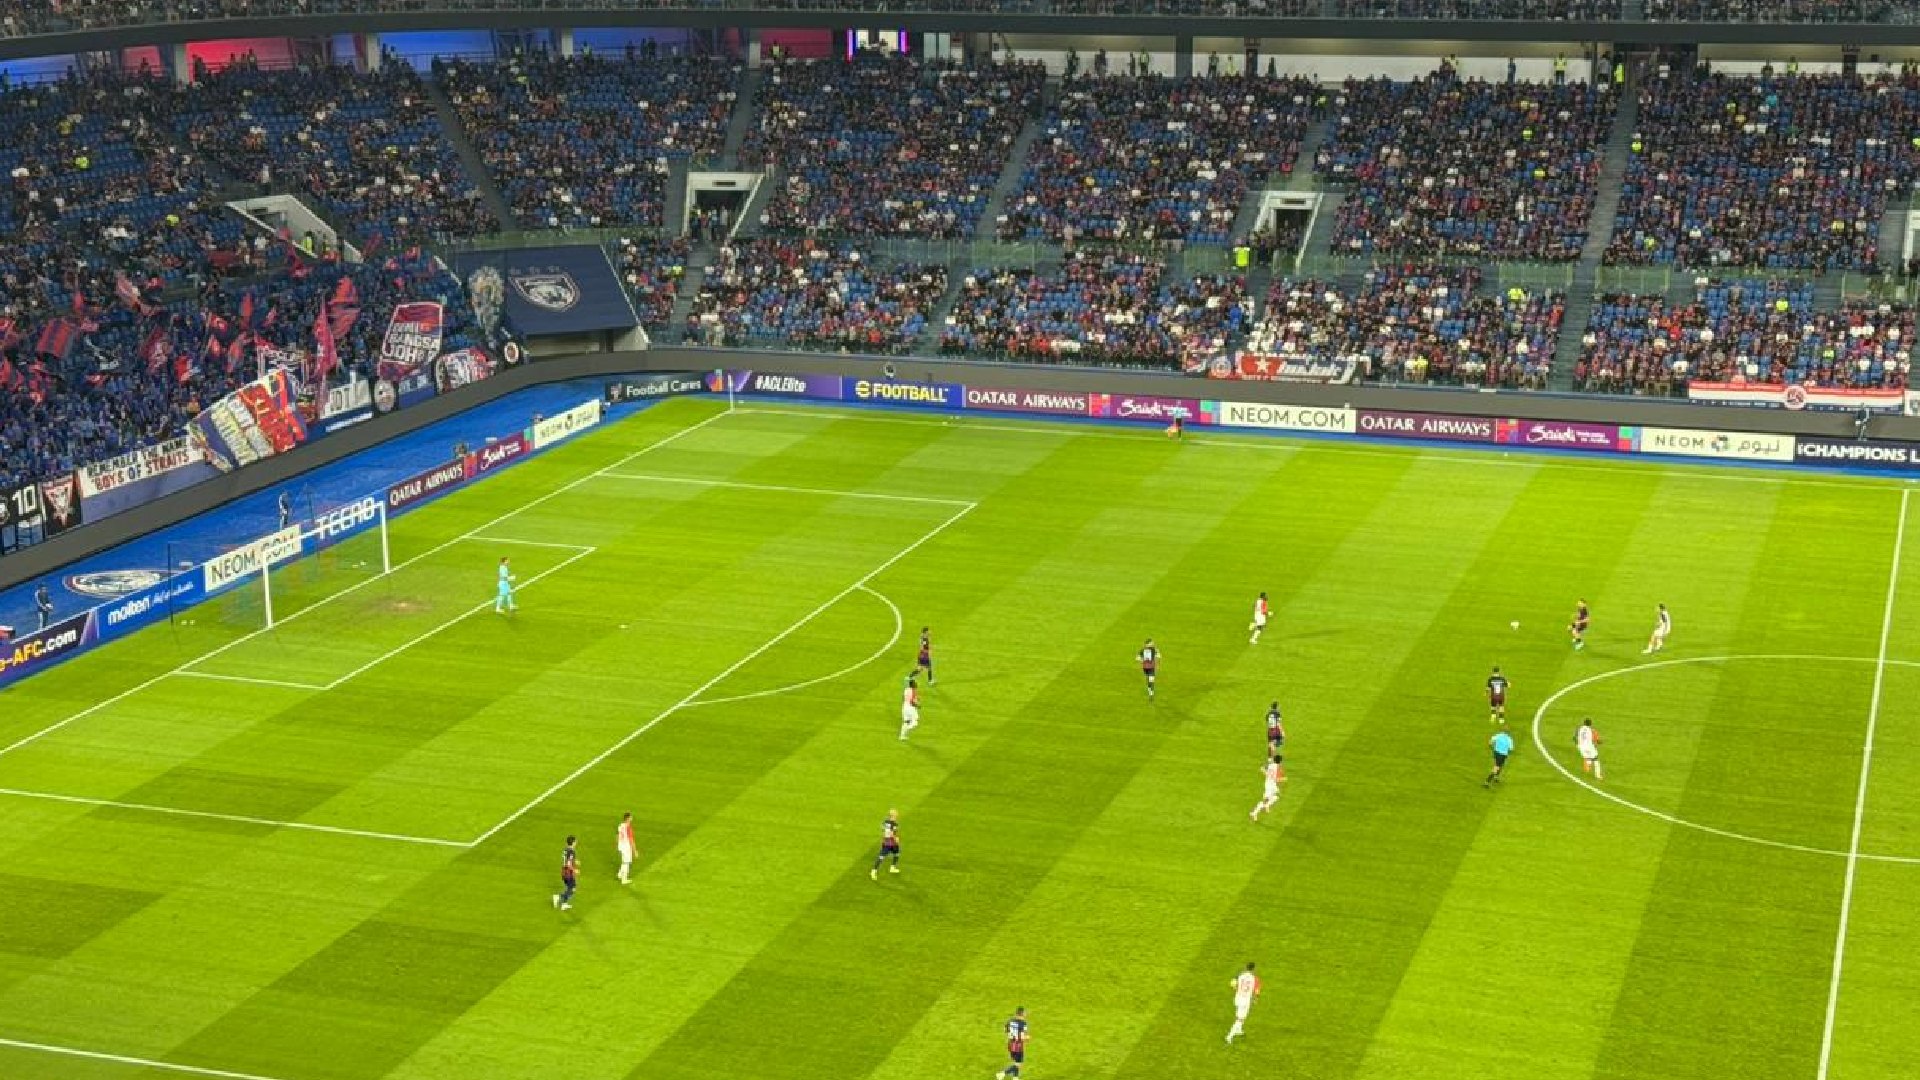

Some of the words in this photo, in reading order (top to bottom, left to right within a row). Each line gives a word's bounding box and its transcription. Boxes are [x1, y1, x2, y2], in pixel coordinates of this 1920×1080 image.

[626, 381, 669, 397] Football
[968, 390, 1017, 406] QATAR
[1023, 391, 1085, 411] AIRWAYS
[1230, 406, 1346, 430] NEOM.COM
[1360, 414, 1416, 432] QATAR
[1421, 418, 1491, 437] AIRWAYS
[1654, 434, 1705, 449] NEOM
[12, 483, 36, 516] 10
[107, 595, 150, 627] molten
